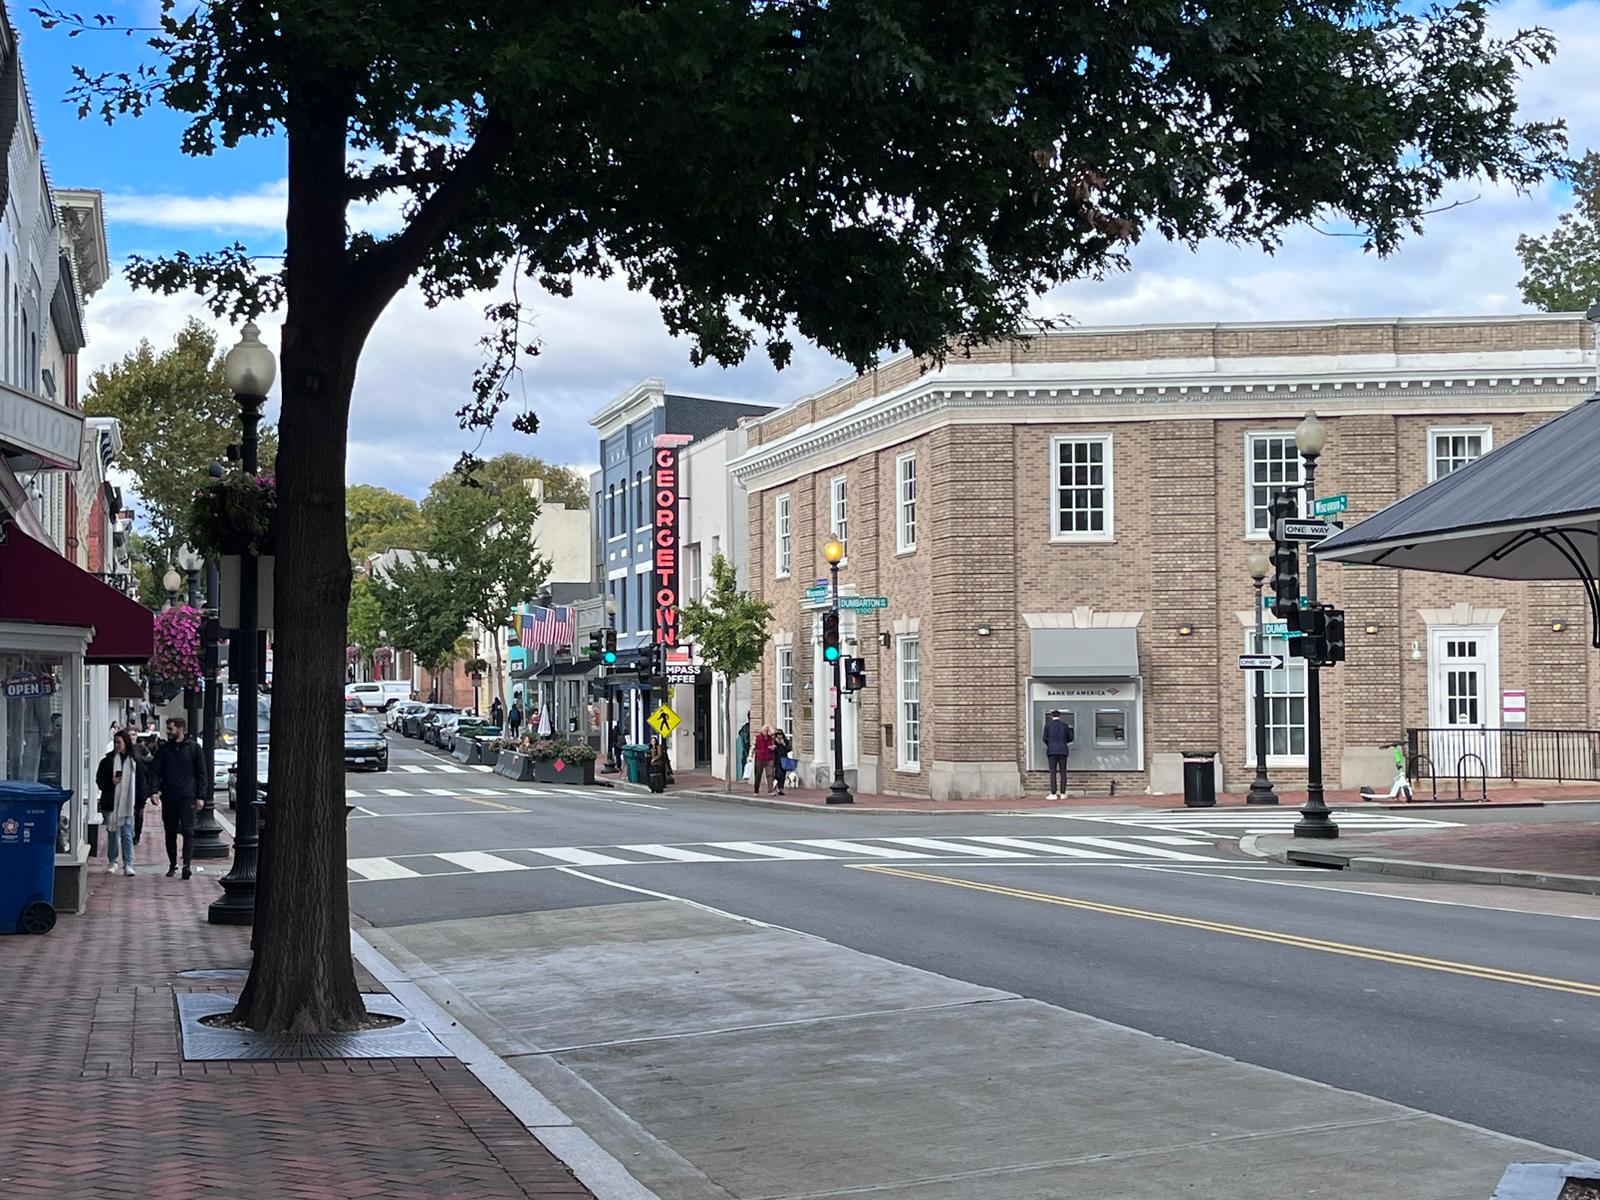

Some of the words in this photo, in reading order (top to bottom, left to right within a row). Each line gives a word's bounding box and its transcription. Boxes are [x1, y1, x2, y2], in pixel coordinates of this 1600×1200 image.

[656, 450, 675, 645] GEORGETOWN
[841, 598, 880, 608] DUMBARTON
[8, 683, 39, 696] OPEN
